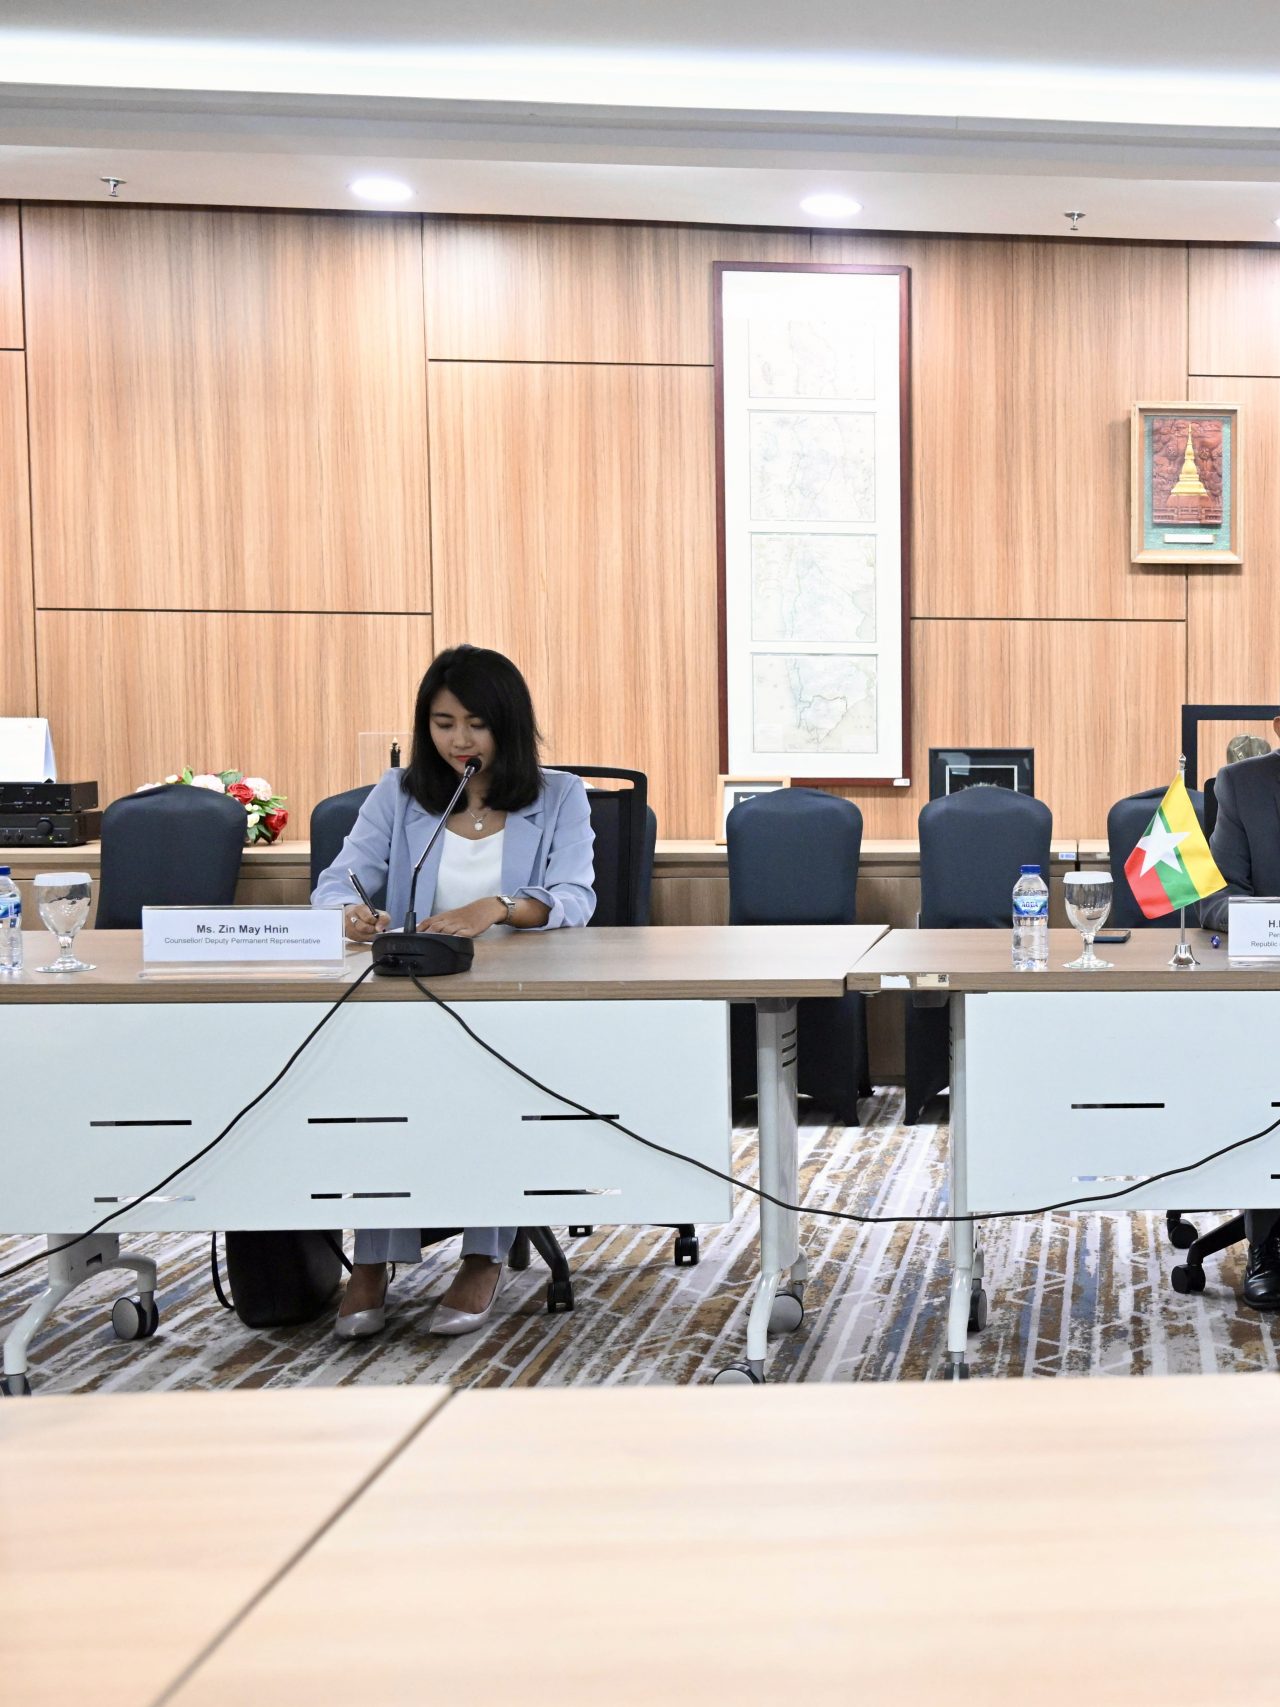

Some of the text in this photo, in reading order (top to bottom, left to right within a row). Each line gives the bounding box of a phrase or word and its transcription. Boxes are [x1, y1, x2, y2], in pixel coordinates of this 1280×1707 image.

[197, 925, 289, 936] Ms. Zin May Hnin
[205, 937, 229, 945] Deputy
[270, 937, 321, 945] Representative
